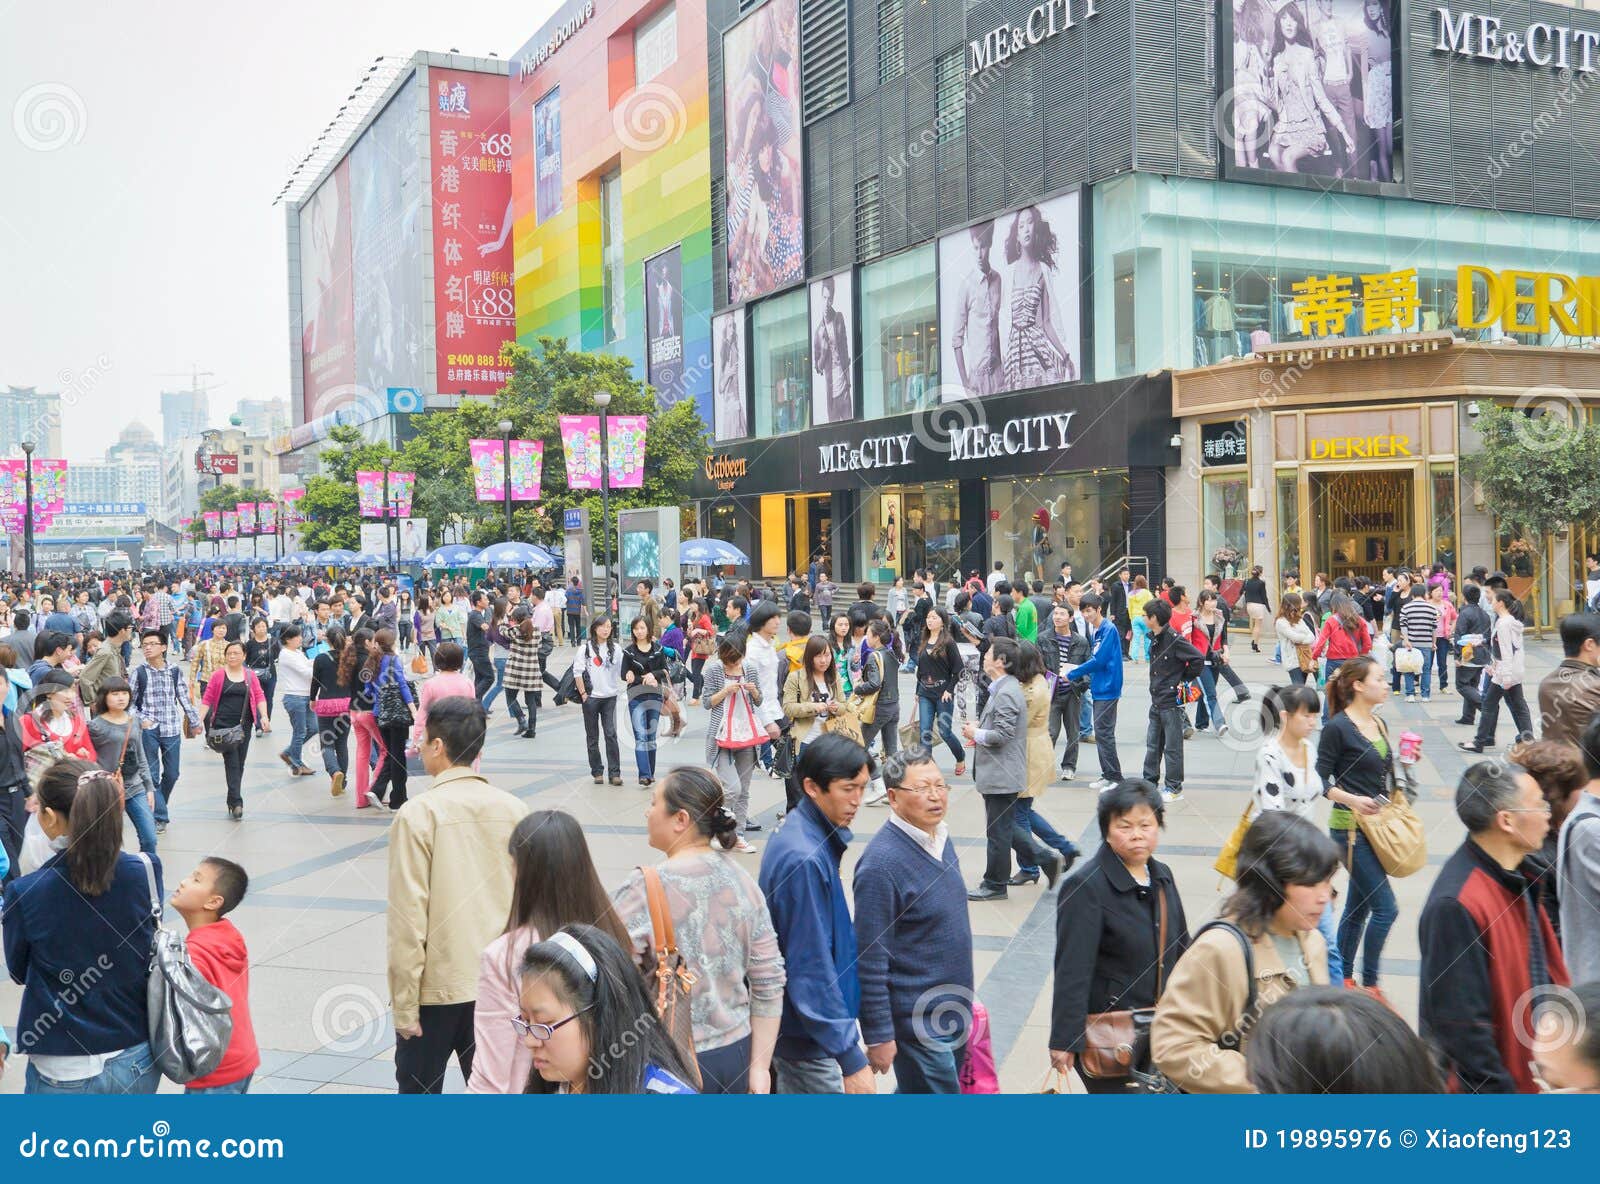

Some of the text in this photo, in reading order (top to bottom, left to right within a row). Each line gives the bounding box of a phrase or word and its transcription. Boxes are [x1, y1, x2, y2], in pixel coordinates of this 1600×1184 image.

[472, 288, 515, 316] ¥88
[1291, 268, 1422, 337] 蒂爵
[1456, 264, 1600, 337] DERI
[477, 354, 494, 366] 888
[949, 411, 1075, 462] ME&CITY
[1311, 434, 1412, 459] DERIER
[213, 458, 236, 466] KFC
[818, 434, 914, 474] ME&CITY
